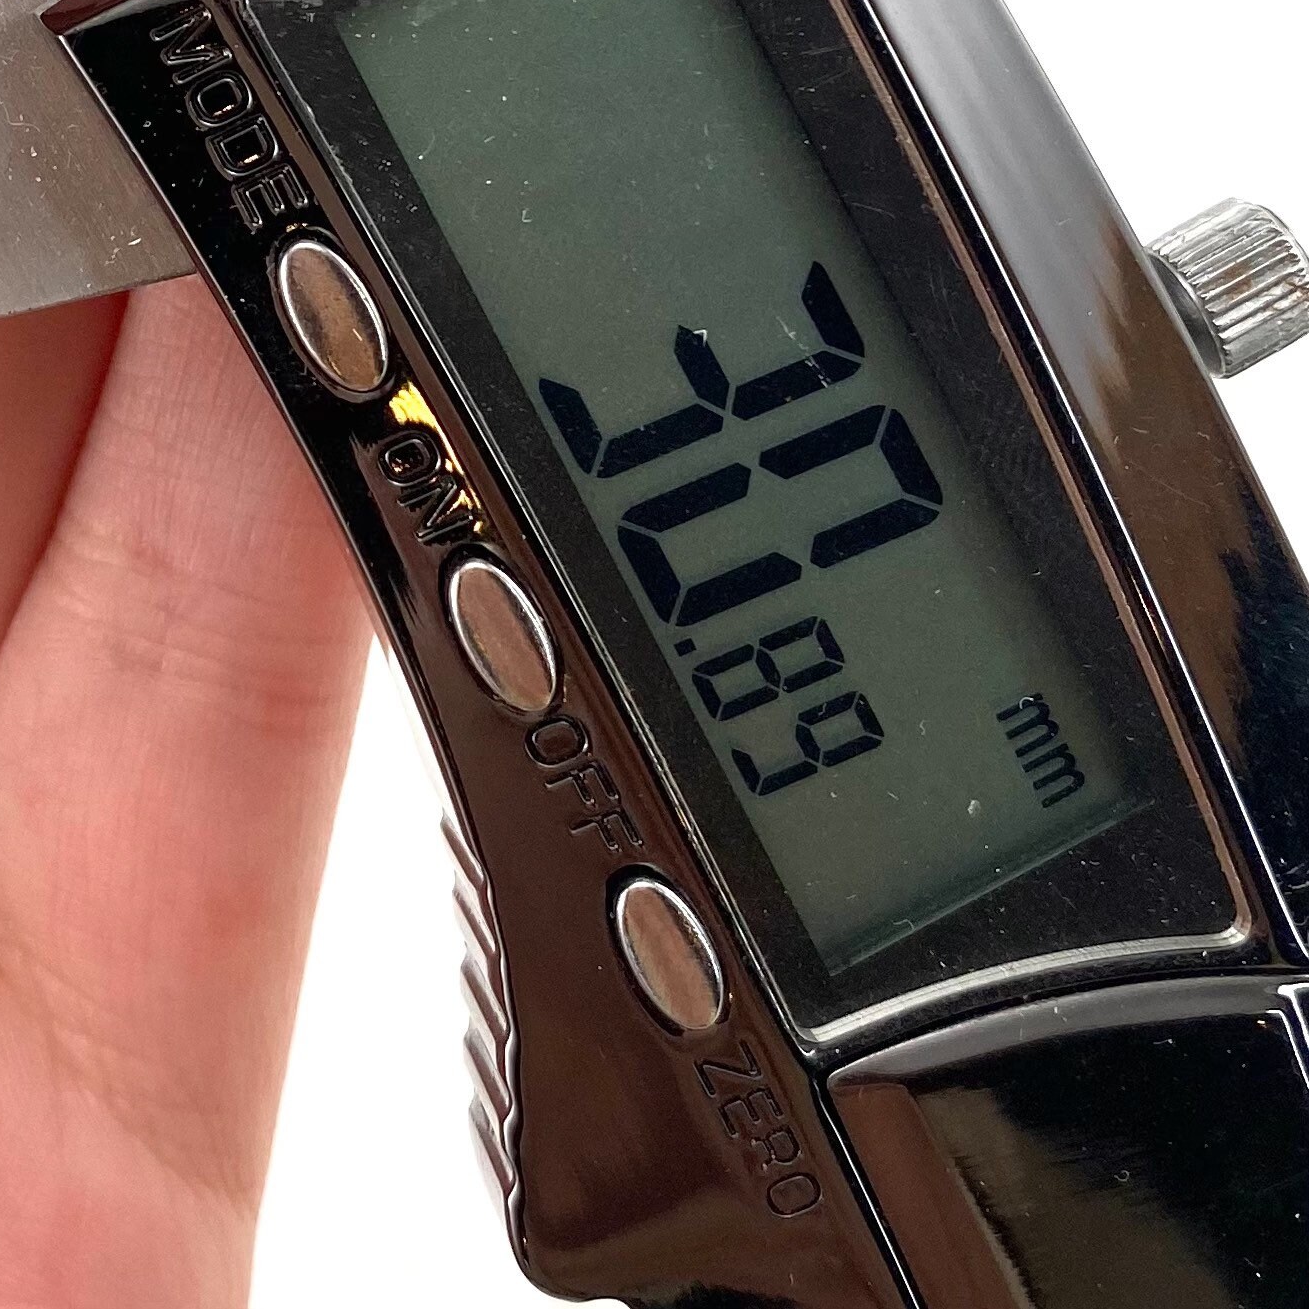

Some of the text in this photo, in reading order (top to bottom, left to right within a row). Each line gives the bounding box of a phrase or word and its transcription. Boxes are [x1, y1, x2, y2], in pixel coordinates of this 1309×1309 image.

[150, 5, 314, 232] MODE
[377, 429, 483, 545] ON
[539, 260, 944, 797] 30.89
[524, 713, 645, 852] OFF
[996, 693, 1086, 809] mm
[693, 1039, 823, 1219] ZERO
